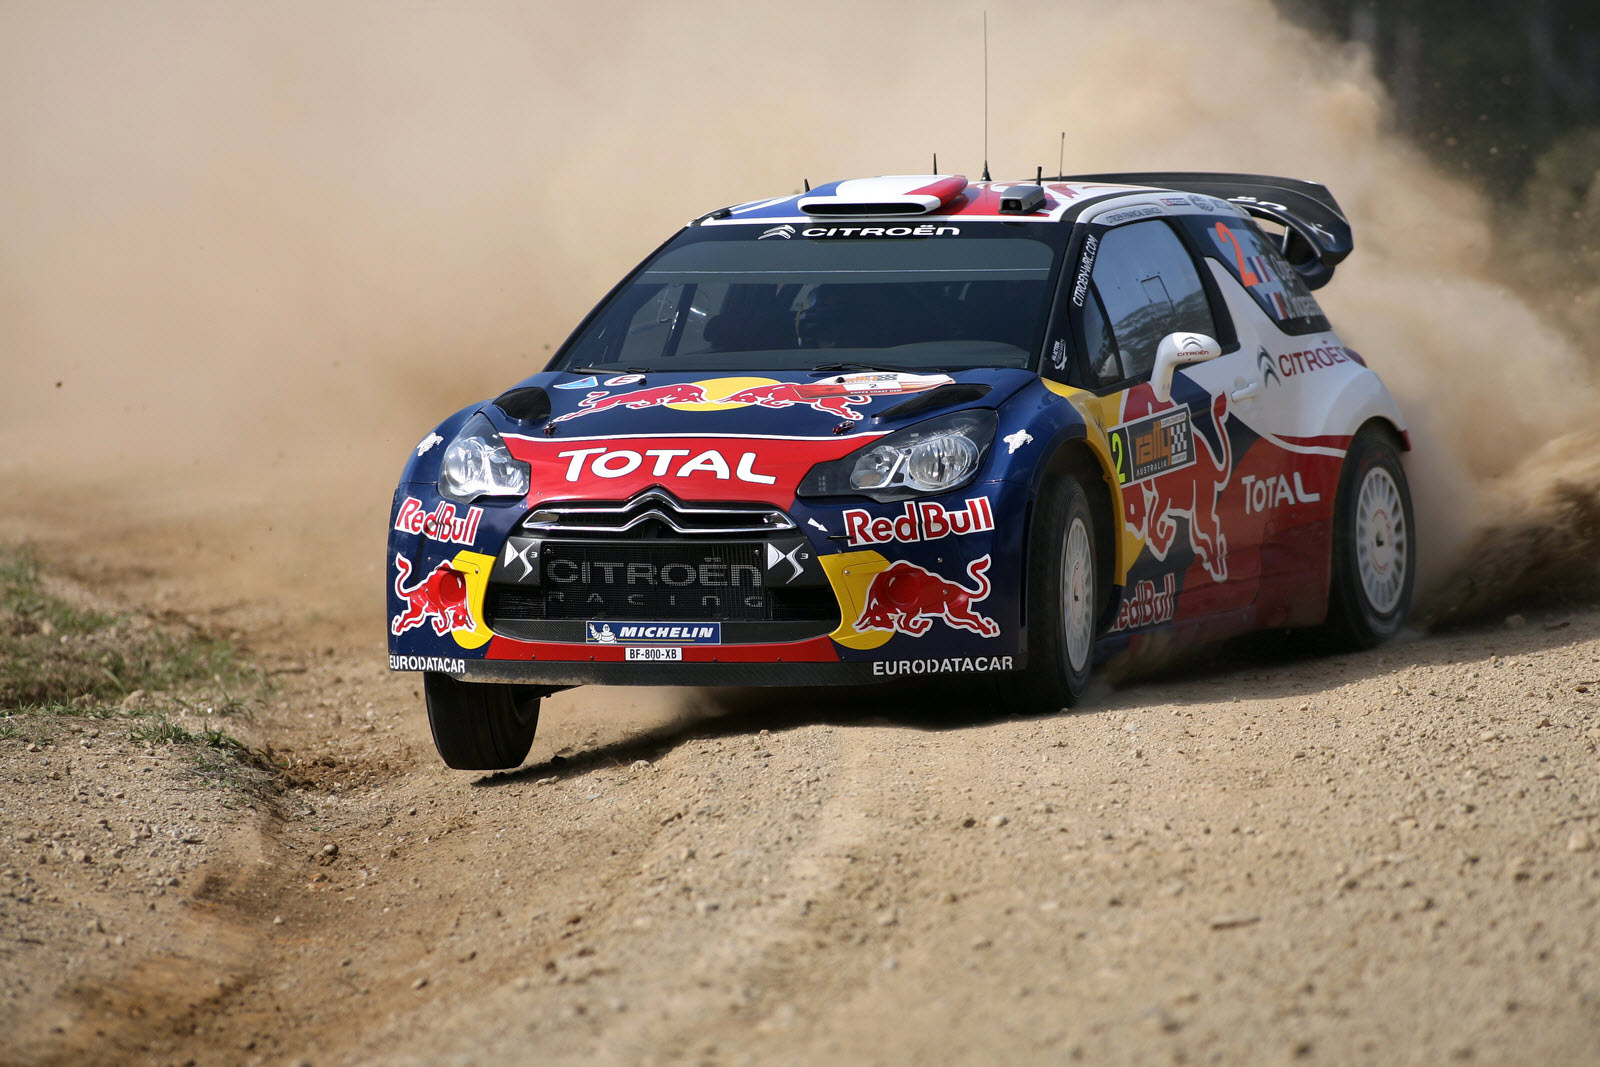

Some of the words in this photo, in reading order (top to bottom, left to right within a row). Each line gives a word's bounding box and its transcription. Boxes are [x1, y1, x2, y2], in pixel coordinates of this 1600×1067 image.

[1215, 222, 1259, 287] 2
[557, 447, 777, 485] TOTAL
[1112, 432, 1125, 484] 2
[1136, 460, 1167, 476] AUSTRALIA
[1241, 471, 1320, 515] TOTAL
[395, 497, 445, 540] Red
[438, 502, 484, 546] Bull
[843, 501, 920, 546] Red
[918, 496, 995, 541] Bull
[1140, 572, 1176, 625] Bull
[619, 626, 714, 638] MICHELIN
[389, 655, 466, 674] EURODATACAR
[629, 648, 677, 660] BF-800-XB
[873, 655, 1013, 676] EURODATACAR
